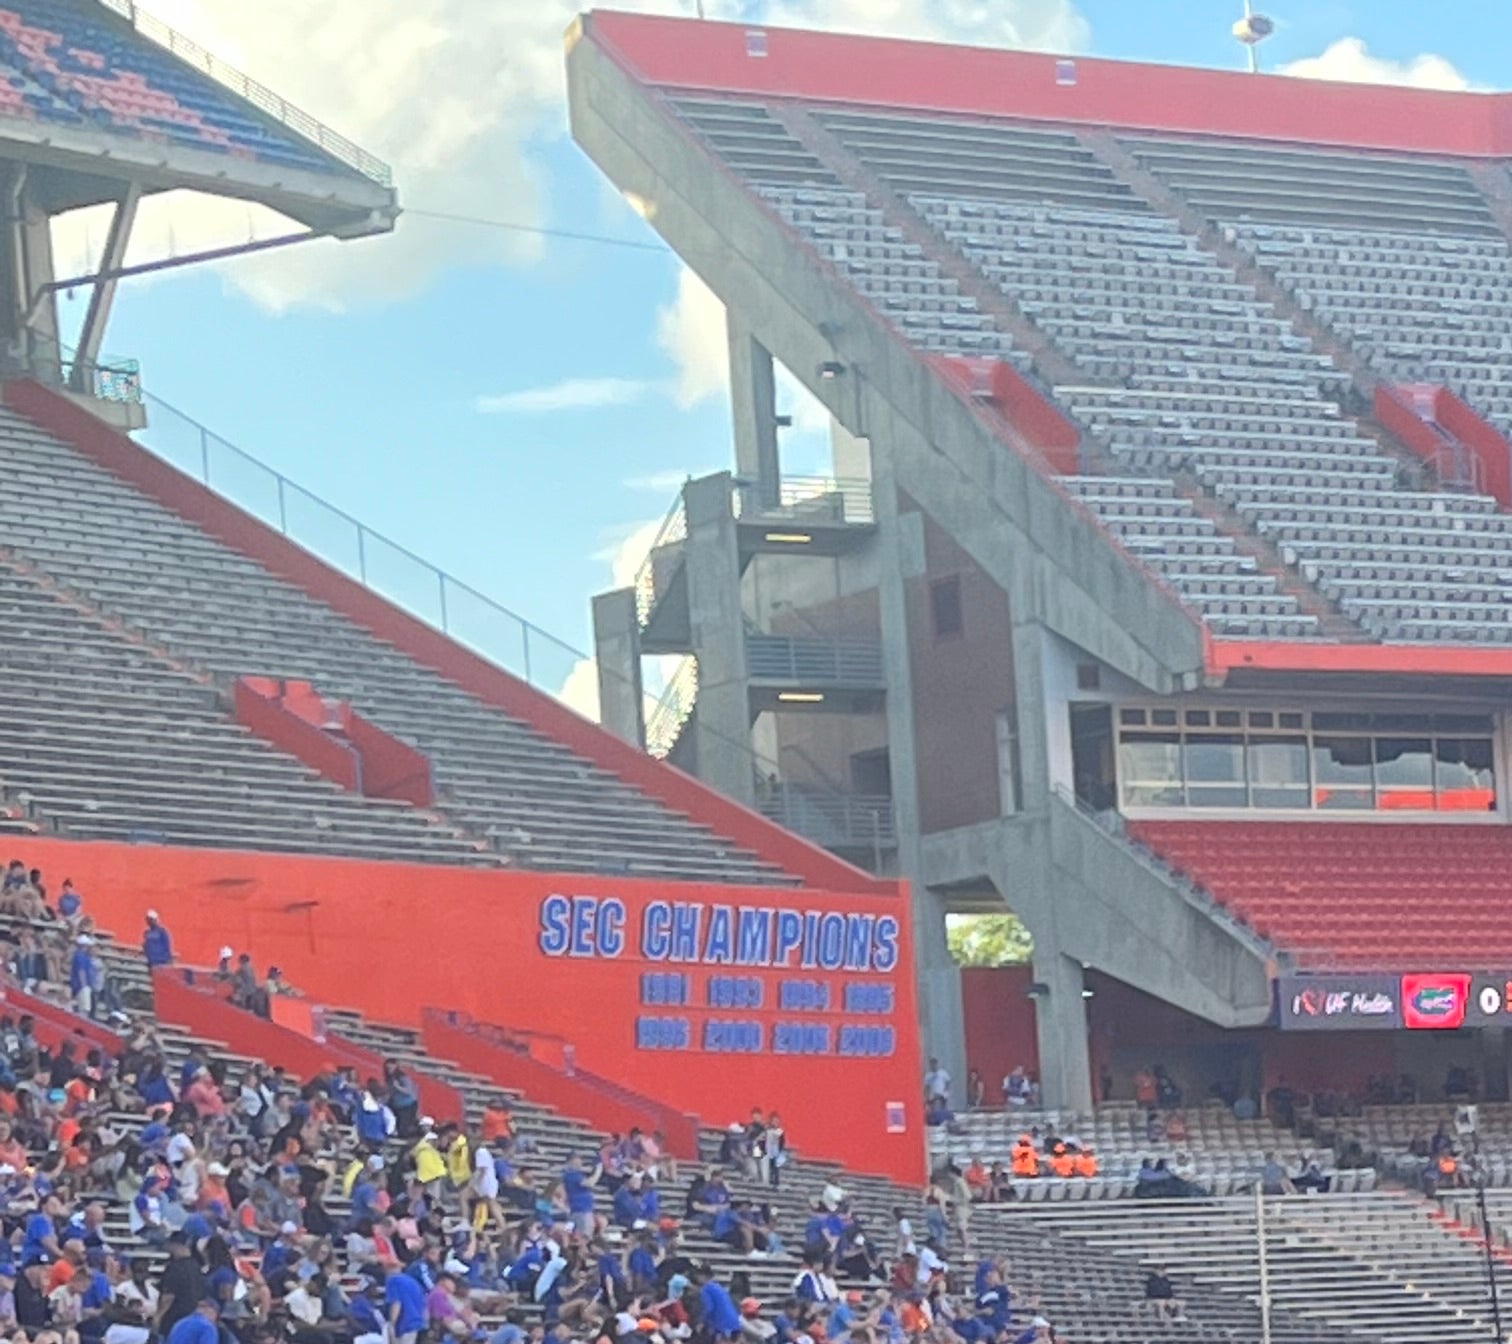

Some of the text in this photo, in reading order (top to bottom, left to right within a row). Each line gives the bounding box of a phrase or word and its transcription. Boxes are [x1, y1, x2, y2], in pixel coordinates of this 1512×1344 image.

[540, 893, 899, 974] SEC CHAMPIONS
[1479, 986, 1501, 1014] 0
